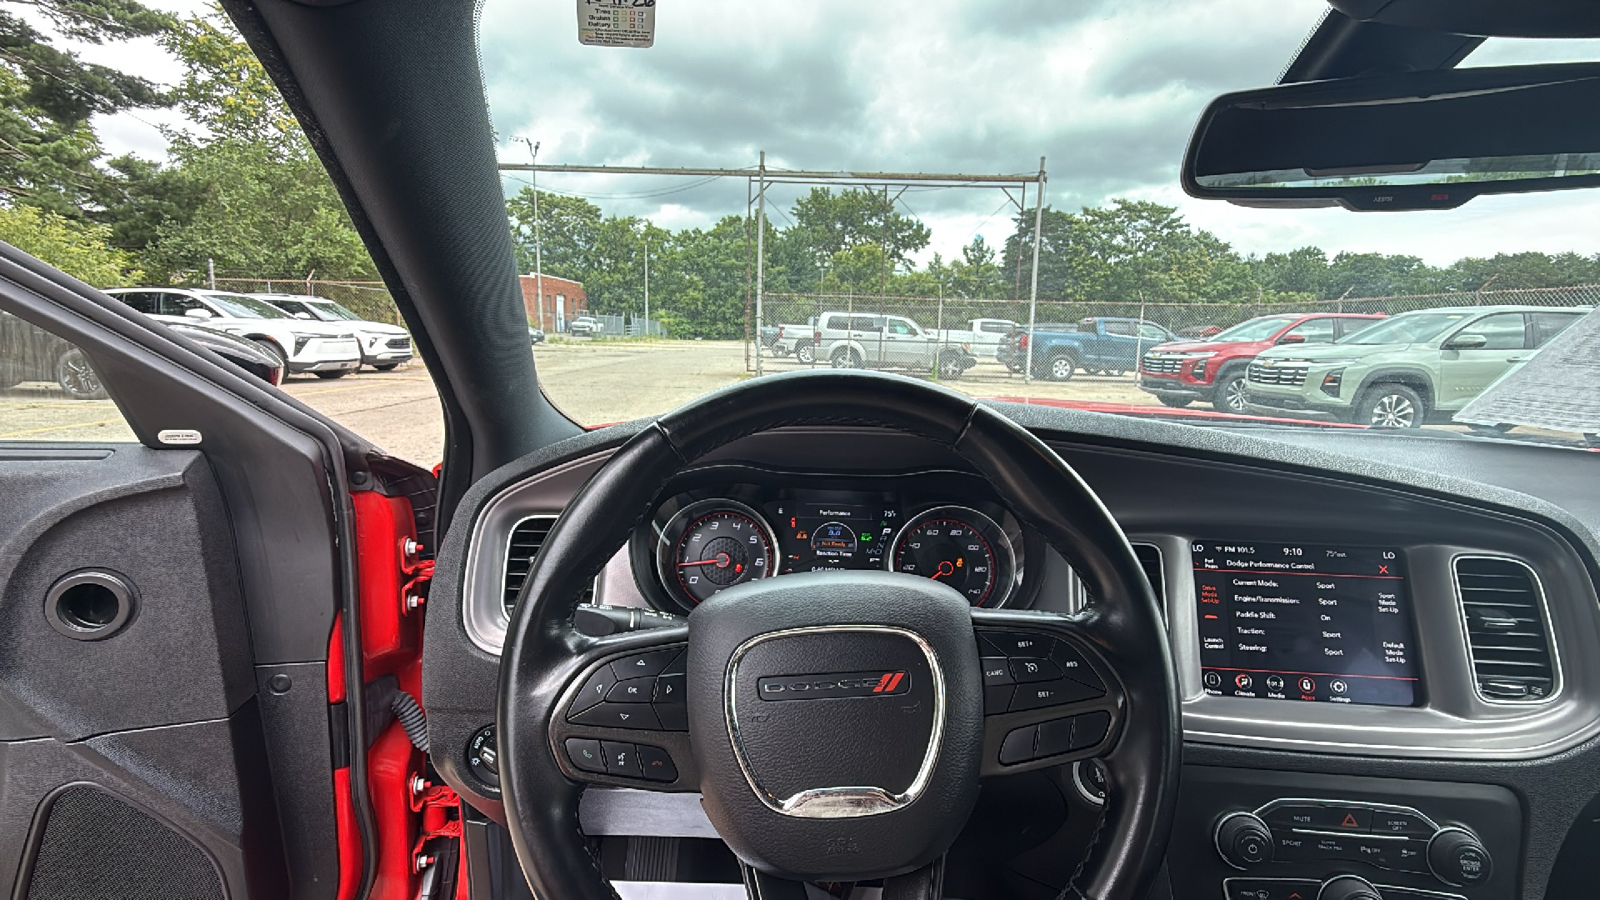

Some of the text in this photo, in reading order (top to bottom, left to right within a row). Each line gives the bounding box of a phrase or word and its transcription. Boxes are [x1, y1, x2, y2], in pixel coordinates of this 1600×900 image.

[710, 522, 719, 530] 3
[692, 534, 702, 542] 2
[749, 536, 758, 544] 5
[1283, 548, 1303, 556] 9:10
[755, 558, 764, 566] 6
[1227, 560, 1249, 568] Dodge
[1250, 561, 1290, 569] Performance
[1318, 598, 1338, 606] Sport
[1322, 631, 1342, 639] Sport
[1325, 648, 1344, 656] Sport
[764, 677, 886, 692] DODGE
